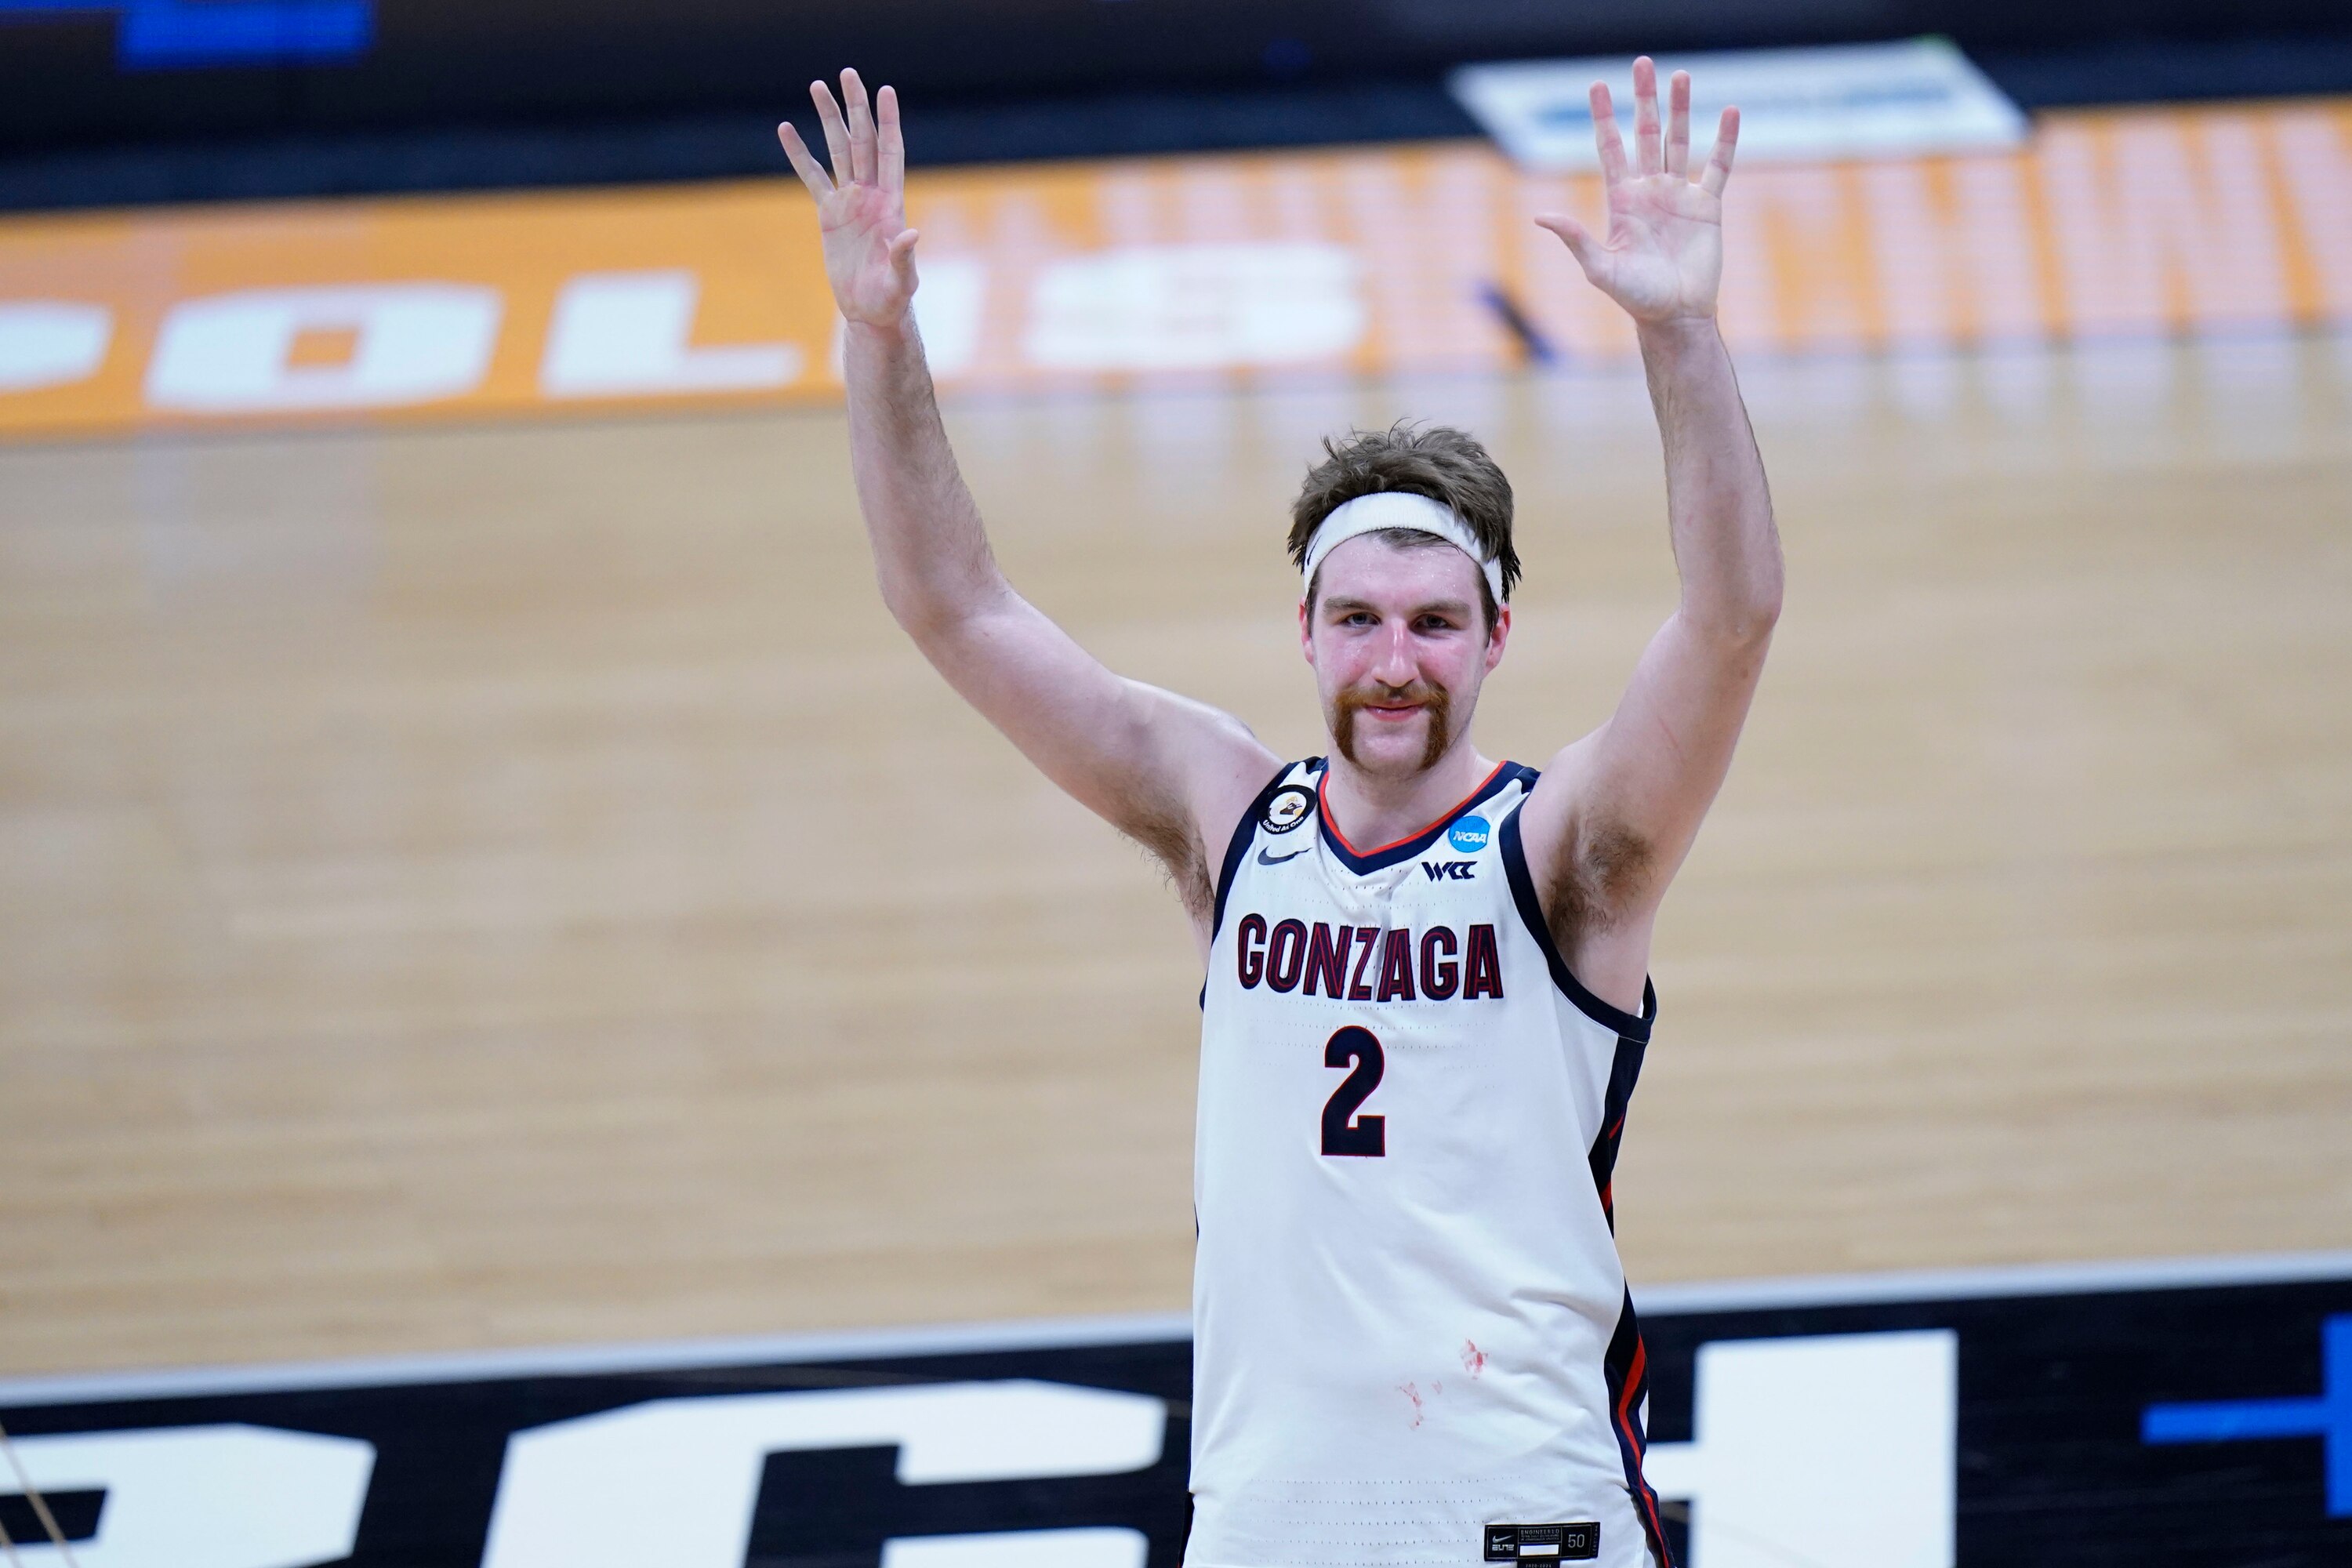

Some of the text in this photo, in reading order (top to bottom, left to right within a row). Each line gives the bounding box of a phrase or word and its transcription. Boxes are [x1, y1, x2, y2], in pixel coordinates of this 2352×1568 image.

[1262, 819, 1281, 832] United
[1290, 816, 1303, 827] One
[1453, 831, 1487, 844] NCAA
[1421, 861, 1478, 882] WCC
[1238, 913, 1504, 1002] GONZAGA
[1321, 1025, 1385, 1156] 2
[1568, 1534, 1585, 1548] 50
